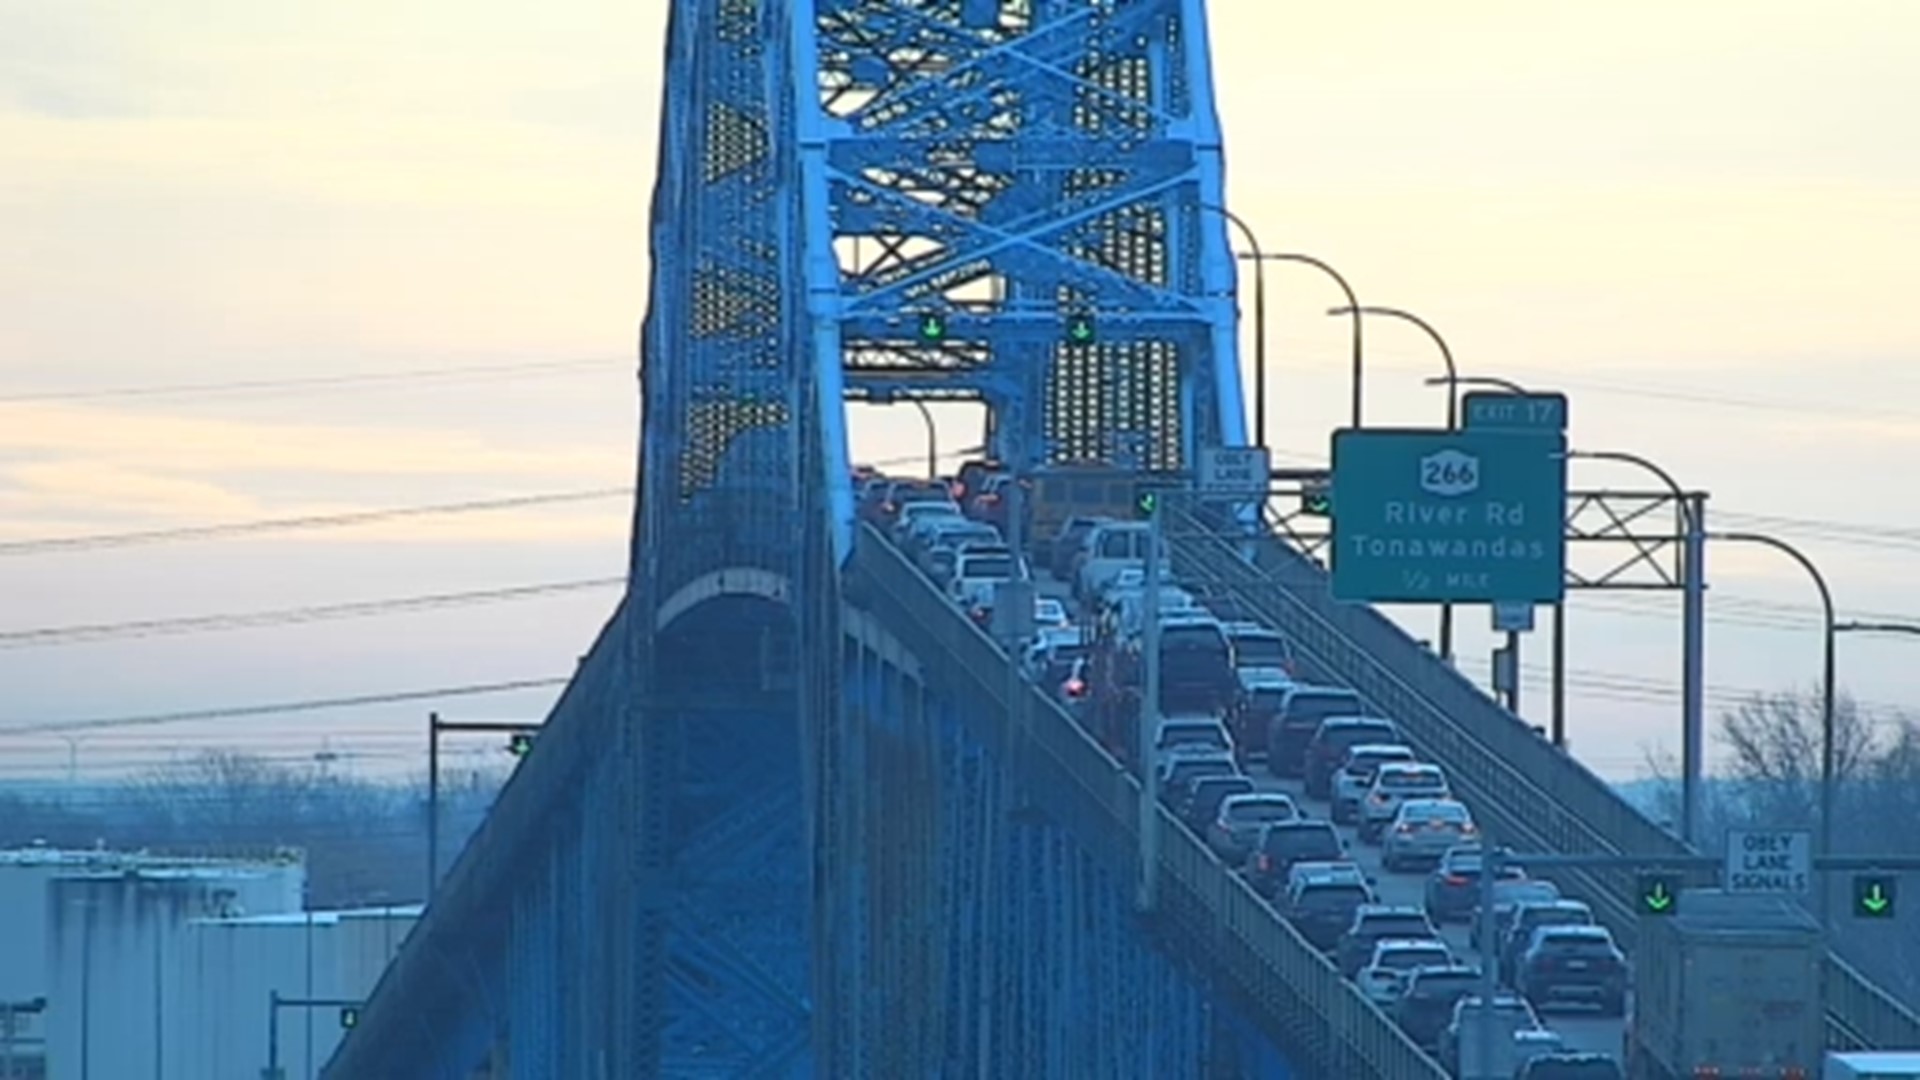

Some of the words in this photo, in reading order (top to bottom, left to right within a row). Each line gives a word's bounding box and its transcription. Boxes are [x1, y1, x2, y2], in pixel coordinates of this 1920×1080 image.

[1472, 404, 1515, 420] EXIT
[1526, 400, 1554, 423] 17
[1425, 462, 1475, 484] 266
[1384, 501, 1468, 525] River
[1486, 501, 1524, 526] Rd
[1349, 534, 1544, 560] Tonawandas
[1446, 572, 1491, 589] MILE
[1743, 855, 1793, 870] LANE
[1732, 873, 1806, 890] SIGNALS
